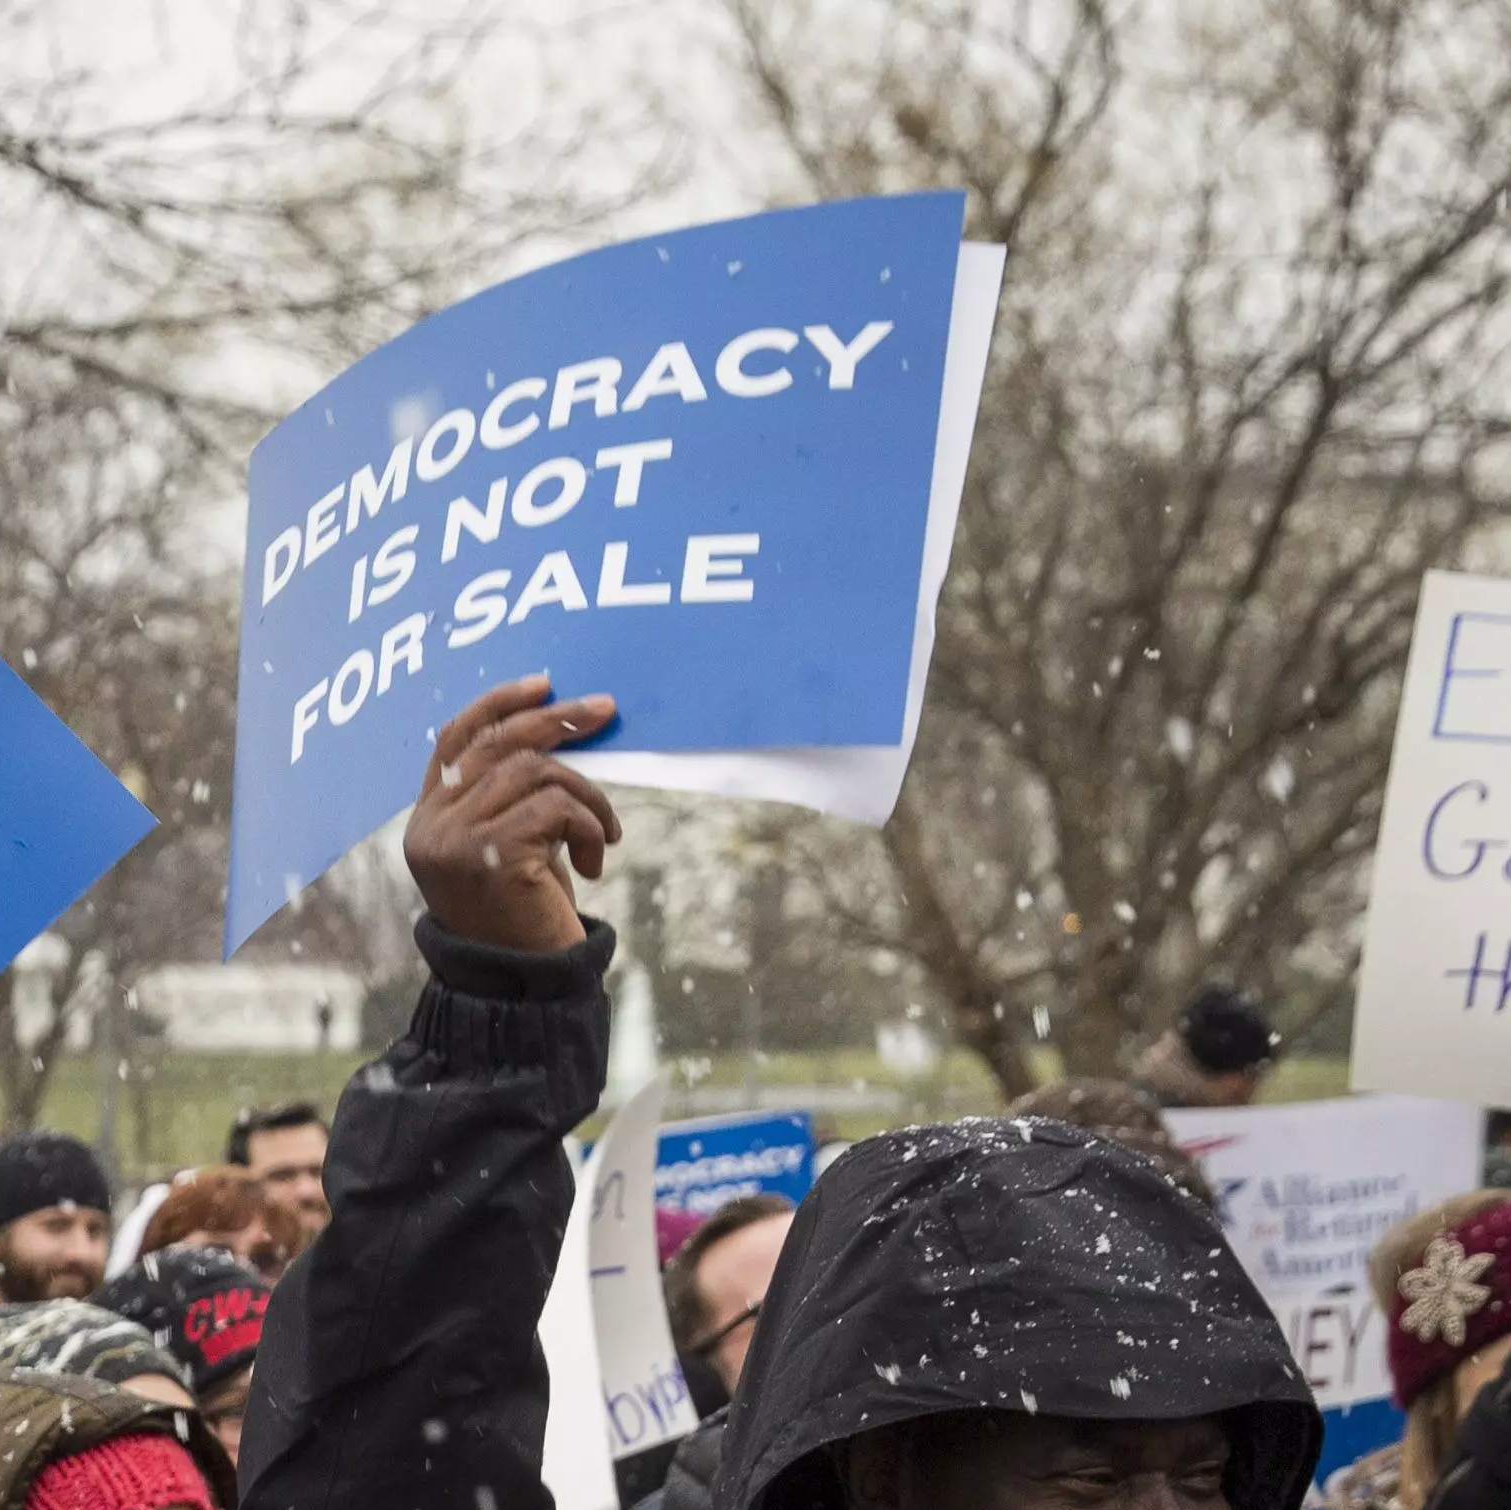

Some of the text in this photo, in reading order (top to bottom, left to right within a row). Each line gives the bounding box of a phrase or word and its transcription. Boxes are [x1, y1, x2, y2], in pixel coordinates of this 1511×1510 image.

[261, 321, 894, 607] DEMOCRACY
[348, 439, 673, 623] IS NOT
[290, 534, 761, 764] FOR SALE
